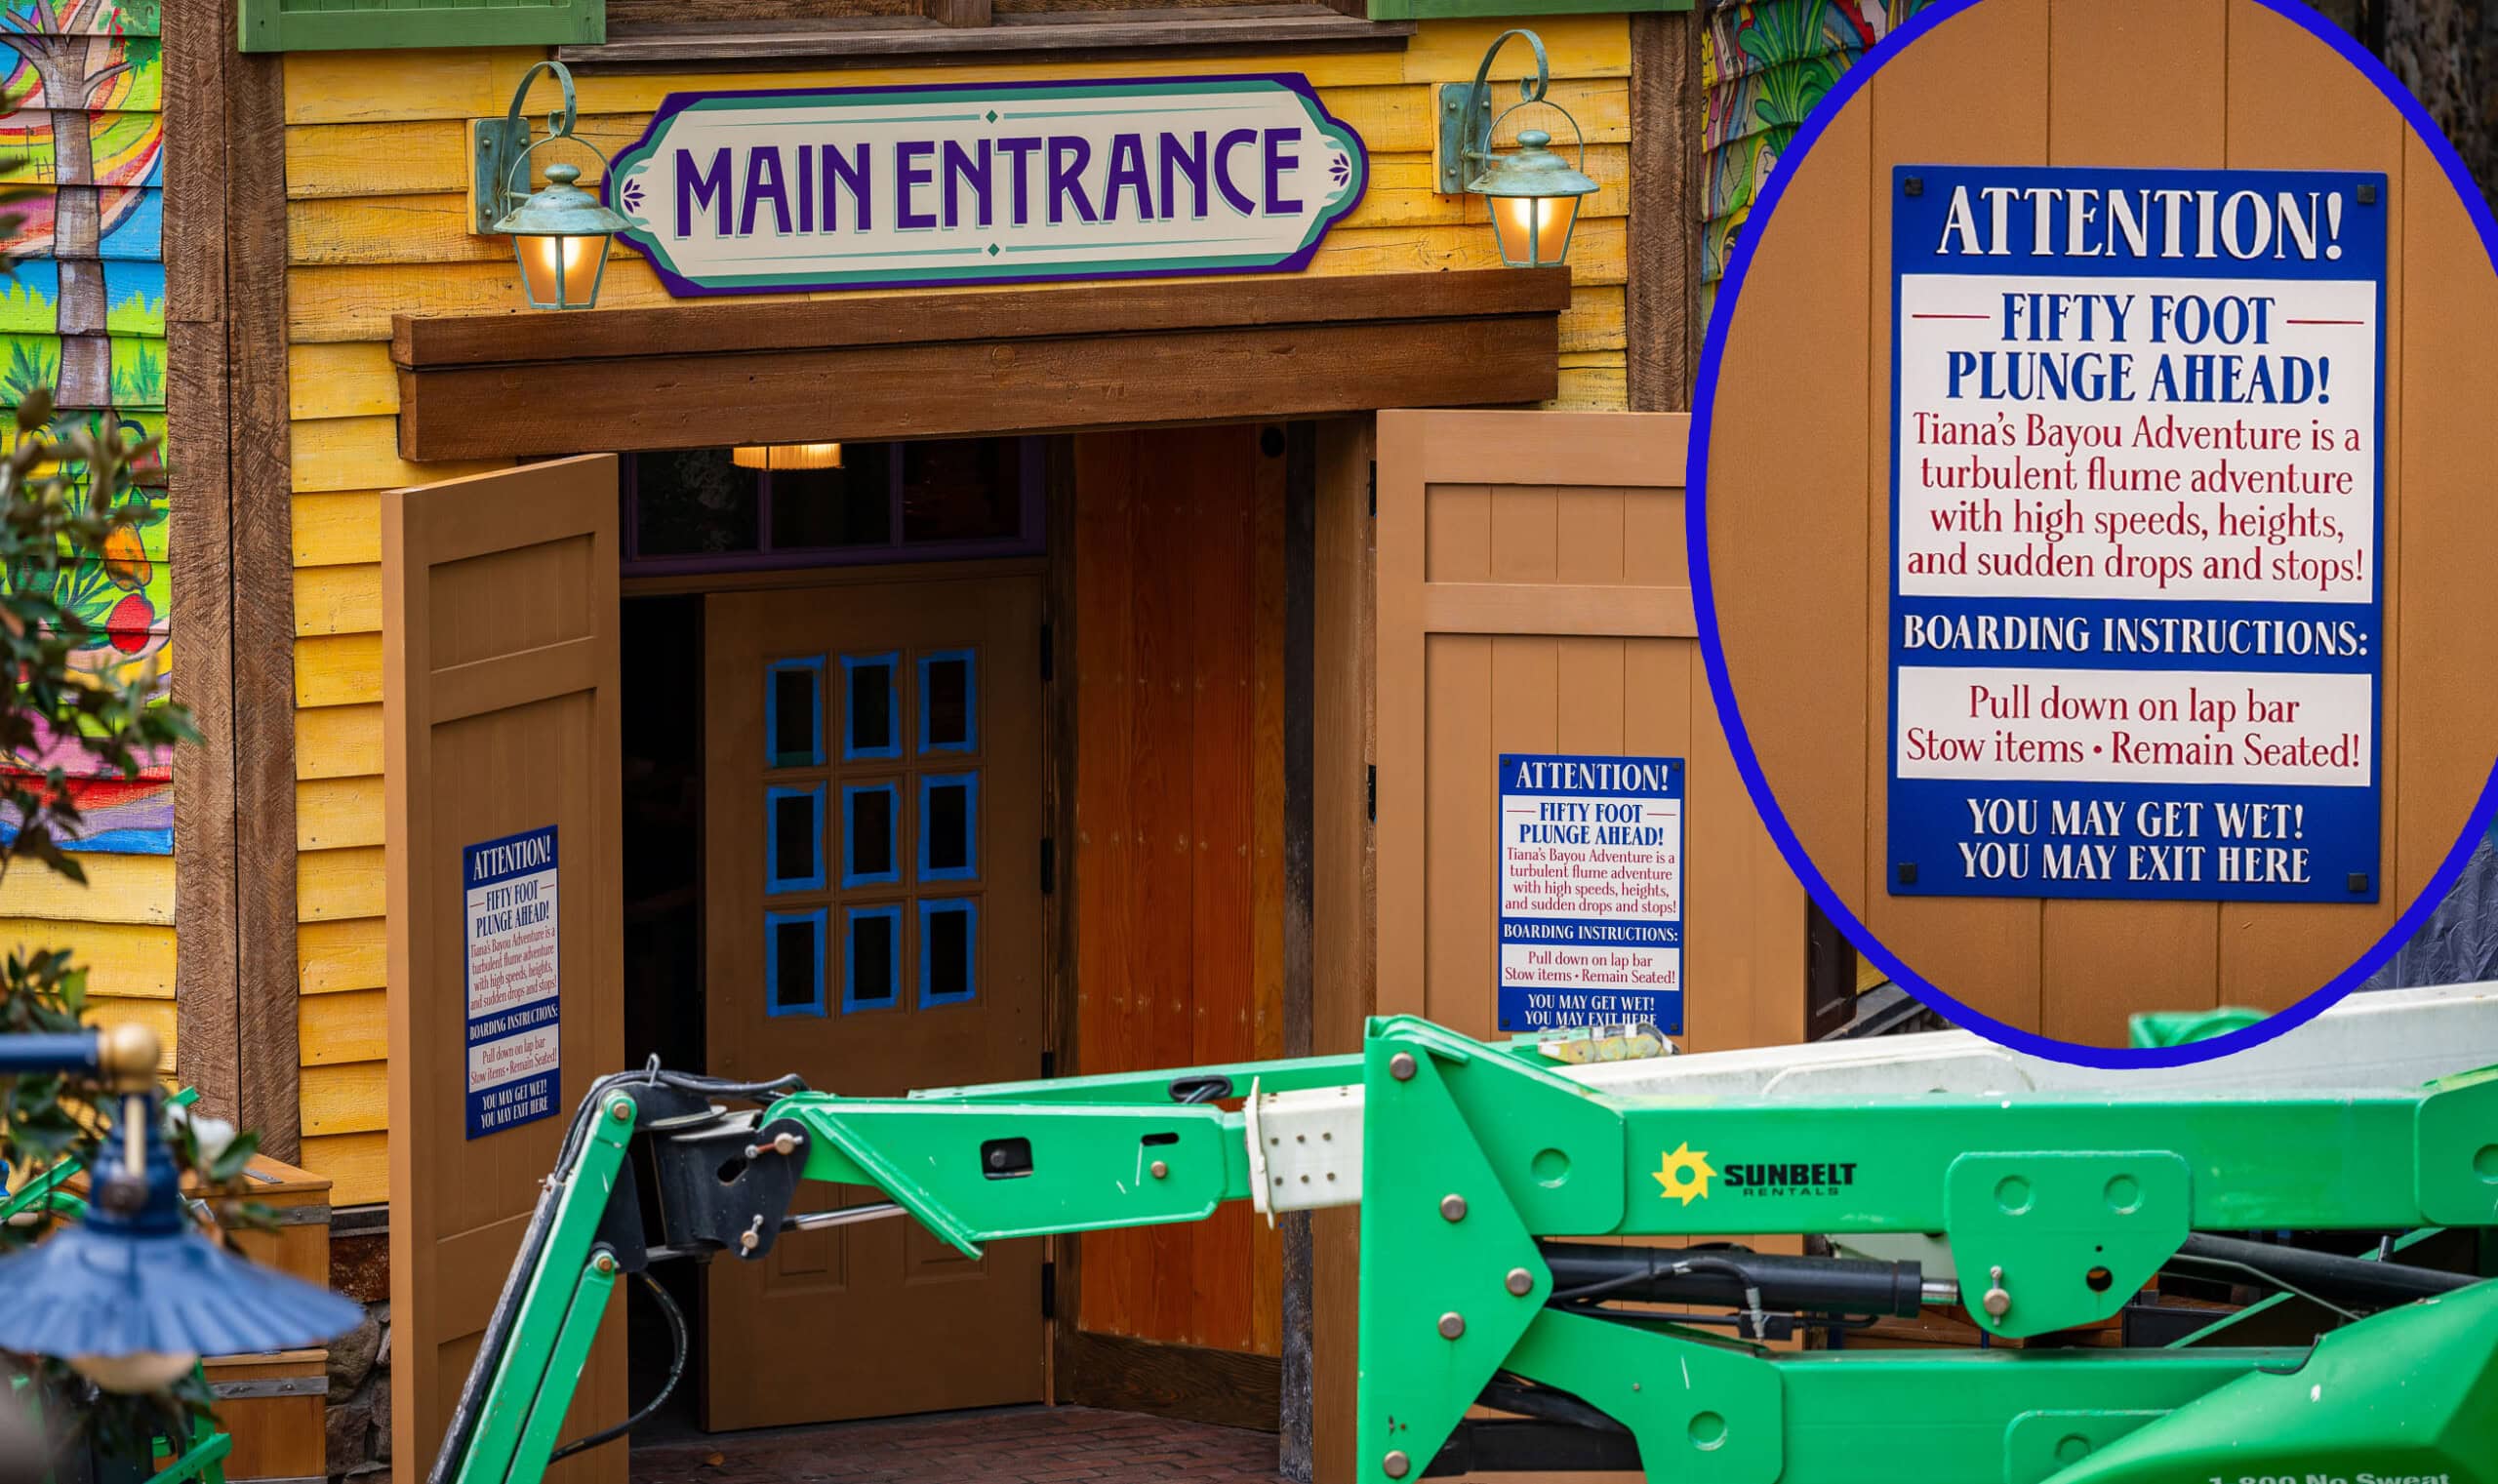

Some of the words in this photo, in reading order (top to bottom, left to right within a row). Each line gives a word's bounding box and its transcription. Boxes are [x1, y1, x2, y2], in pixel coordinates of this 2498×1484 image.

[674, 142, 871, 239] MAIN
[894, 127, 1304, 232] ENTRANCE
[1936, 185, 2342, 260] ATTENTION!
[2001, 293, 2135, 341] FIFTY
[2150, 296, 2275, 344] FOOT
[1946, 351, 2136, 402] PLUNGE
[2149, 354, 2330, 404] AHEAD!
[1914, 411, 2016, 447] Tiana's
[2027, 414, 2122, 458] Bayou
[2132, 415, 2301, 452] Adventure
[2312, 419, 2334, 452] is
[2346, 428, 2359, 452] a
[1920, 455, 2075, 491] turbulent
[2087, 457, 2181, 492] flume
[2192, 458, 2353, 495] adventure
[1930, 498, 2002, 534] with
[2014, 499, 2083, 542] high
[2094, 501, 2209, 542] speeds,
[2218, 501, 2344, 544] heights,
[1907, 542, 1967, 575] and
[1977, 543, 2094, 577] sudden
[2105, 544, 2193, 588] drops
[2202, 546, 2262, 581] and
[2272, 549, 2363, 590] stops!
[1903, 615, 2090, 652] BOARDING
[2103, 618, 2368, 656] INSTRUCTIONS:
[1969, 685, 2030, 719] Pull
[2040, 685, 2127, 720] down
[2139, 697, 2178, 721] on
[2189, 687, 2236, 732] lap
[2247, 688, 2299, 723] bar
[1906, 728, 1985, 762] Stow
[1994, 731, 2083, 763] items
[2112, 732, 2234, 765] Remain
[2244, 734, 2359, 768] Seated!
[1516, 761, 1668, 791] ATTENTION!
[1540, 802, 1590, 822] FIFTY
[1595, 803, 1642, 823] FOOT
[1967, 799, 2037, 834] YOU
[2051, 800, 2125, 837] MAY
[2137, 802, 2203, 838] GET
[2214, 804, 2304, 839] WET!
[1519, 824, 1590, 844] PLUNGE
[1595, 826, 1664, 846] AHEAD!
[473, 835, 550, 881] ATTENTION!
[1508, 847, 1546, 861] Tiana's
[1550, 848, 1585, 864] Bayou
[1590, 849, 1652, 863] Adventure
[1656, 851, 1666, 863] is
[1669, 856, 1674, 864] a
[1957, 842, 2030, 878] YOU
[2042, 844, 2117, 880] MAY
[2128, 846, 2205, 881] EXIT
[2218, 848, 2311, 883] HERE
[1511, 864, 1569, 878] turbulent
[1573, 864, 1607, 879] flume
[1611, 865, 1672, 880] adventure
[486, 886, 512, 911] FIFTY
[515, 879, 539, 904] FOOT
[1513, 881, 1541, 895] with
[1545, 881, 1571, 898] high
[1575, 883, 1618, 899] speeds,
[1622, 883, 1670, 901] heights,
[476, 910, 512, 938] PLUNGE
[515, 901, 548, 928] AHEAD!
[1505, 898, 1528, 910] and
[1531, 898, 1575, 911] sudden
[1579, 899, 1612, 915] drops
[1616, 900, 1637, 912] and
[1641, 900, 1676, 916] stops!
[471, 940, 490, 957] Tiana's
[492, 939, 510, 953] Bayou
[512, 931, 544, 946] Adventure
[545, 926, 550, 938] is
[551, 927, 554, 937] a
[1504, 924, 1573, 939] BOARDING
[1578, 926, 1678, 942] INSTRUCTIONS:
[472, 953, 502, 975] turbulent
[504, 952, 521, 966] flume
[523, 944, 553, 961] adventure
[1528, 951, 1551, 964] Pull
[1555, 952, 1588, 965] down
[1591, 956, 1607, 965] on
[1611, 952, 1629, 970] lap
[1632, 953, 1652, 967] bar
[474, 976, 488, 991] with
[491, 971, 504, 989] high
[505, 965, 526, 986] speeds,
[528, 960, 552, 978] heights,
[1506, 968, 1534, 981] Stow
[1538, 968, 1572, 982] items
[1582, 969, 1628, 983] Remain
[1632, 971, 1675, 984] Seated!
[470, 994, 482, 1010] and
[484, 990, 506, 1007] sudden
[508, 986, 524, 1003] drops
[526, 979, 538, 994] and
[539, 974, 556, 993] stops!
[1528, 994, 1554, 1009] YOU
[1559, 995, 1587, 1010] MAY
[1591, 995, 1617, 1010] GET
[1621, 996, 1654, 1011] WET!
[469, 1018, 505, 1040] BOARDING
[507, 1003, 558, 1031] INSTRUCTIONS:
[1525, 1011, 1551, 1025] YOU
[1556, 1012, 1585, 1026] MAY
[1589, 1013, 1618, 1025] EXIT
[1622, 1014, 1657, 1026] HERE
[482, 1047, 495, 1064] Pull
[497, 1046, 513, 1060] down
[515, 1045, 523, 1056] on
[524, 1038, 534, 1055] lap
[535, 1035, 545, 1050] bar
[471, 1070, 486, 1085] Stow
[488, 1065, 504, 1081] items
[510, 1057, 533, 1072] Remain
[535, 1047, 556, 1065] Seated!
[482, 1094, 497, 1110] YOU
[499, 1088, 512, 1105] MAY
[515, 1083, 528, 1102] GET
[530, 1079, 546, 1096] WET!
[481, 1110, 495, 1129] YOU
[498, 1106, 512, 1124] MAY
[514, 1101, 528, 1120] EXIT
[531, 1096, 547, 1113] HERE
[1723, 1163, 1857, 1186] SUNBELT
[1743, 1187, 1838, 1196] RENTALS
[2208, 1475, 2294, 1484] 1800
